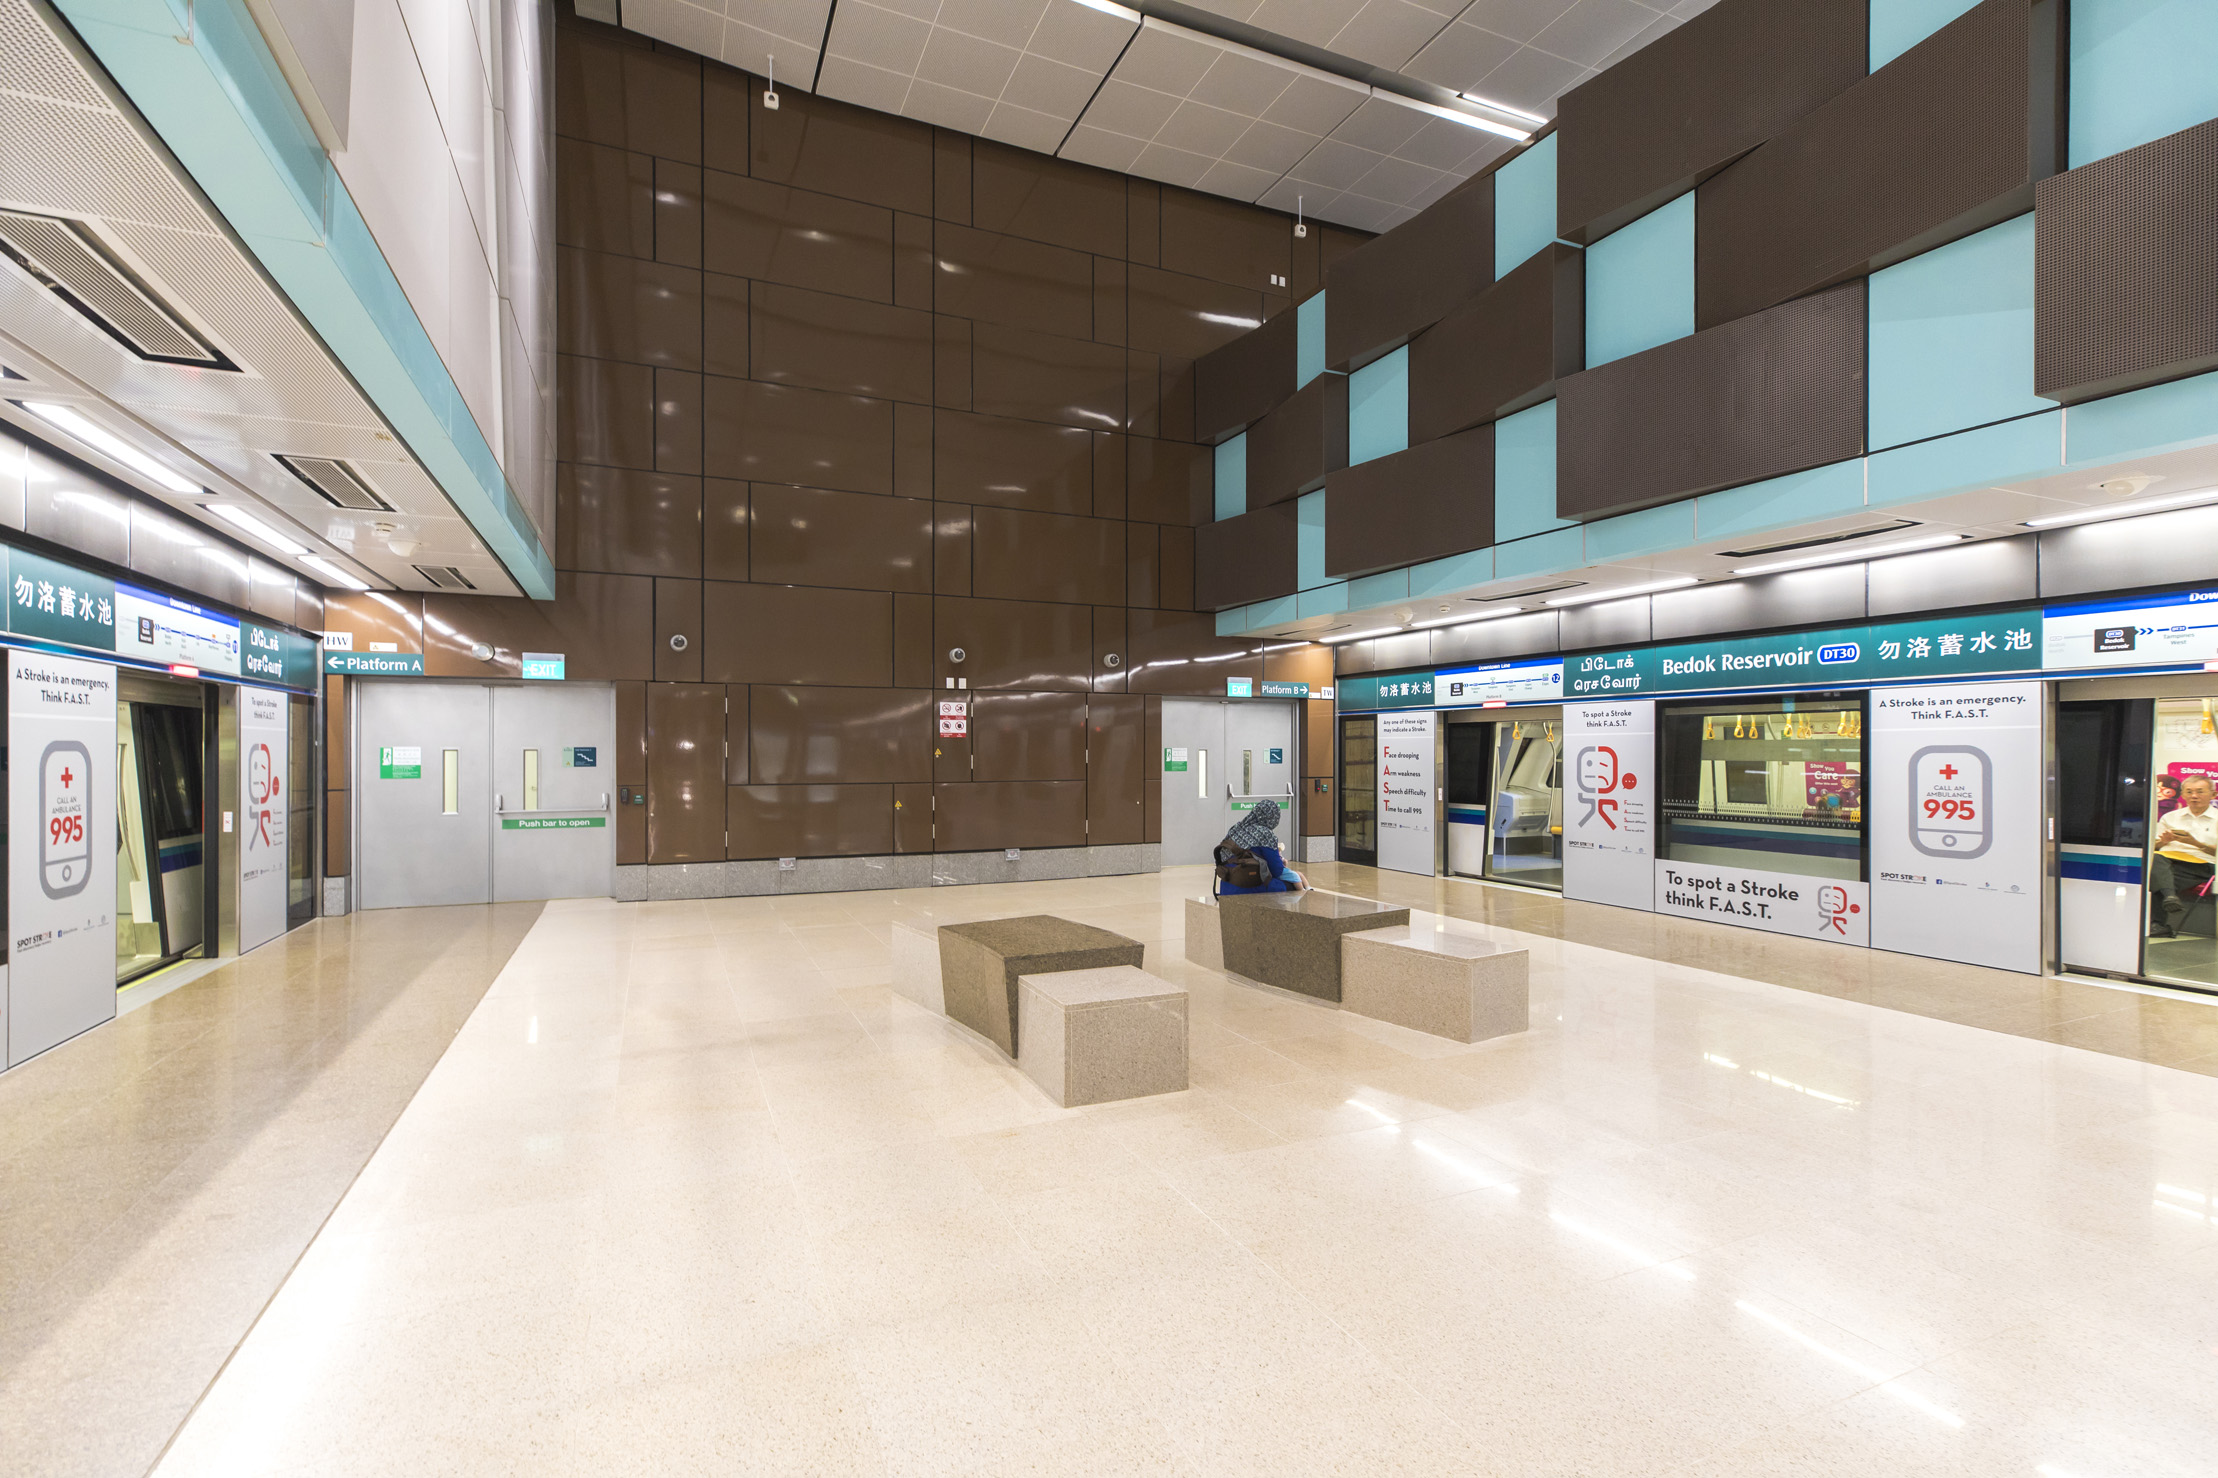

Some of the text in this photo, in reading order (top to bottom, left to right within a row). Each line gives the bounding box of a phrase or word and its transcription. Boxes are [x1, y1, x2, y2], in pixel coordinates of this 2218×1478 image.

[14, 574, 113, 626] 勿洛蓄水池
[326, 635, 349, 646] HW
[1878, 628, 2034, 660] 勿洛蓄水池
[347, 657, 422, 671] Platform A
[1662, 646, 1855, 675] Bedok Reservoir DT30
[531, 663, 557, 676] EXIT
[16, 667, 110, 691] A Stroke is an emergency.
[1232, 685, 1248, 695] EXIT
[1261, 685, 1299, 695] Platform B
[1323, 689, 1333, 697] TW
[1379, 680, 1433, 698] 勿洛蓄水池
[41, 689, 91, 705] Think F.A.S.T.
[1879, 695, 2026, 708] A Stroke is an emergency.
[1590, 710, 1605, 719] spot
[1610, 709, 1632, 717] Stroke
[1911, 708, 1989, 720] Think F.A.S.T.
[1416, 718, 1427, 726] signs
[1603, 719, 1627, 727] F.A.S.T.
[1383, 746, 1420, 760] Face drooping
[1383, 764, 1397, 776] Arm
[1814, 770, 1839, 780] Care
[2180, 766, 2206, 775] Show
[1383, 781, 1427, 798] Speech difficulty
[1926, 791, 1973, 799] AMBULANCE
[56, 797, 69, 805] CALL
[1383, 799, 1397, 813] Time
[1403, 806, 1412, 814] call
[1412, 807, 1422, 815] 995
[51, 804, 82, 815] AMBULANCE
[1923, 798, 1976, 821] 995
[50, 815, 83, 846] 995
[519, 819, 590, 829] Push bar to open
[1666, 870, 1800, 901] To spot a Stroke
[1665, 890, 1773, 920] think F.A.S.T.
[17, 935, 32, 950] SPOT
